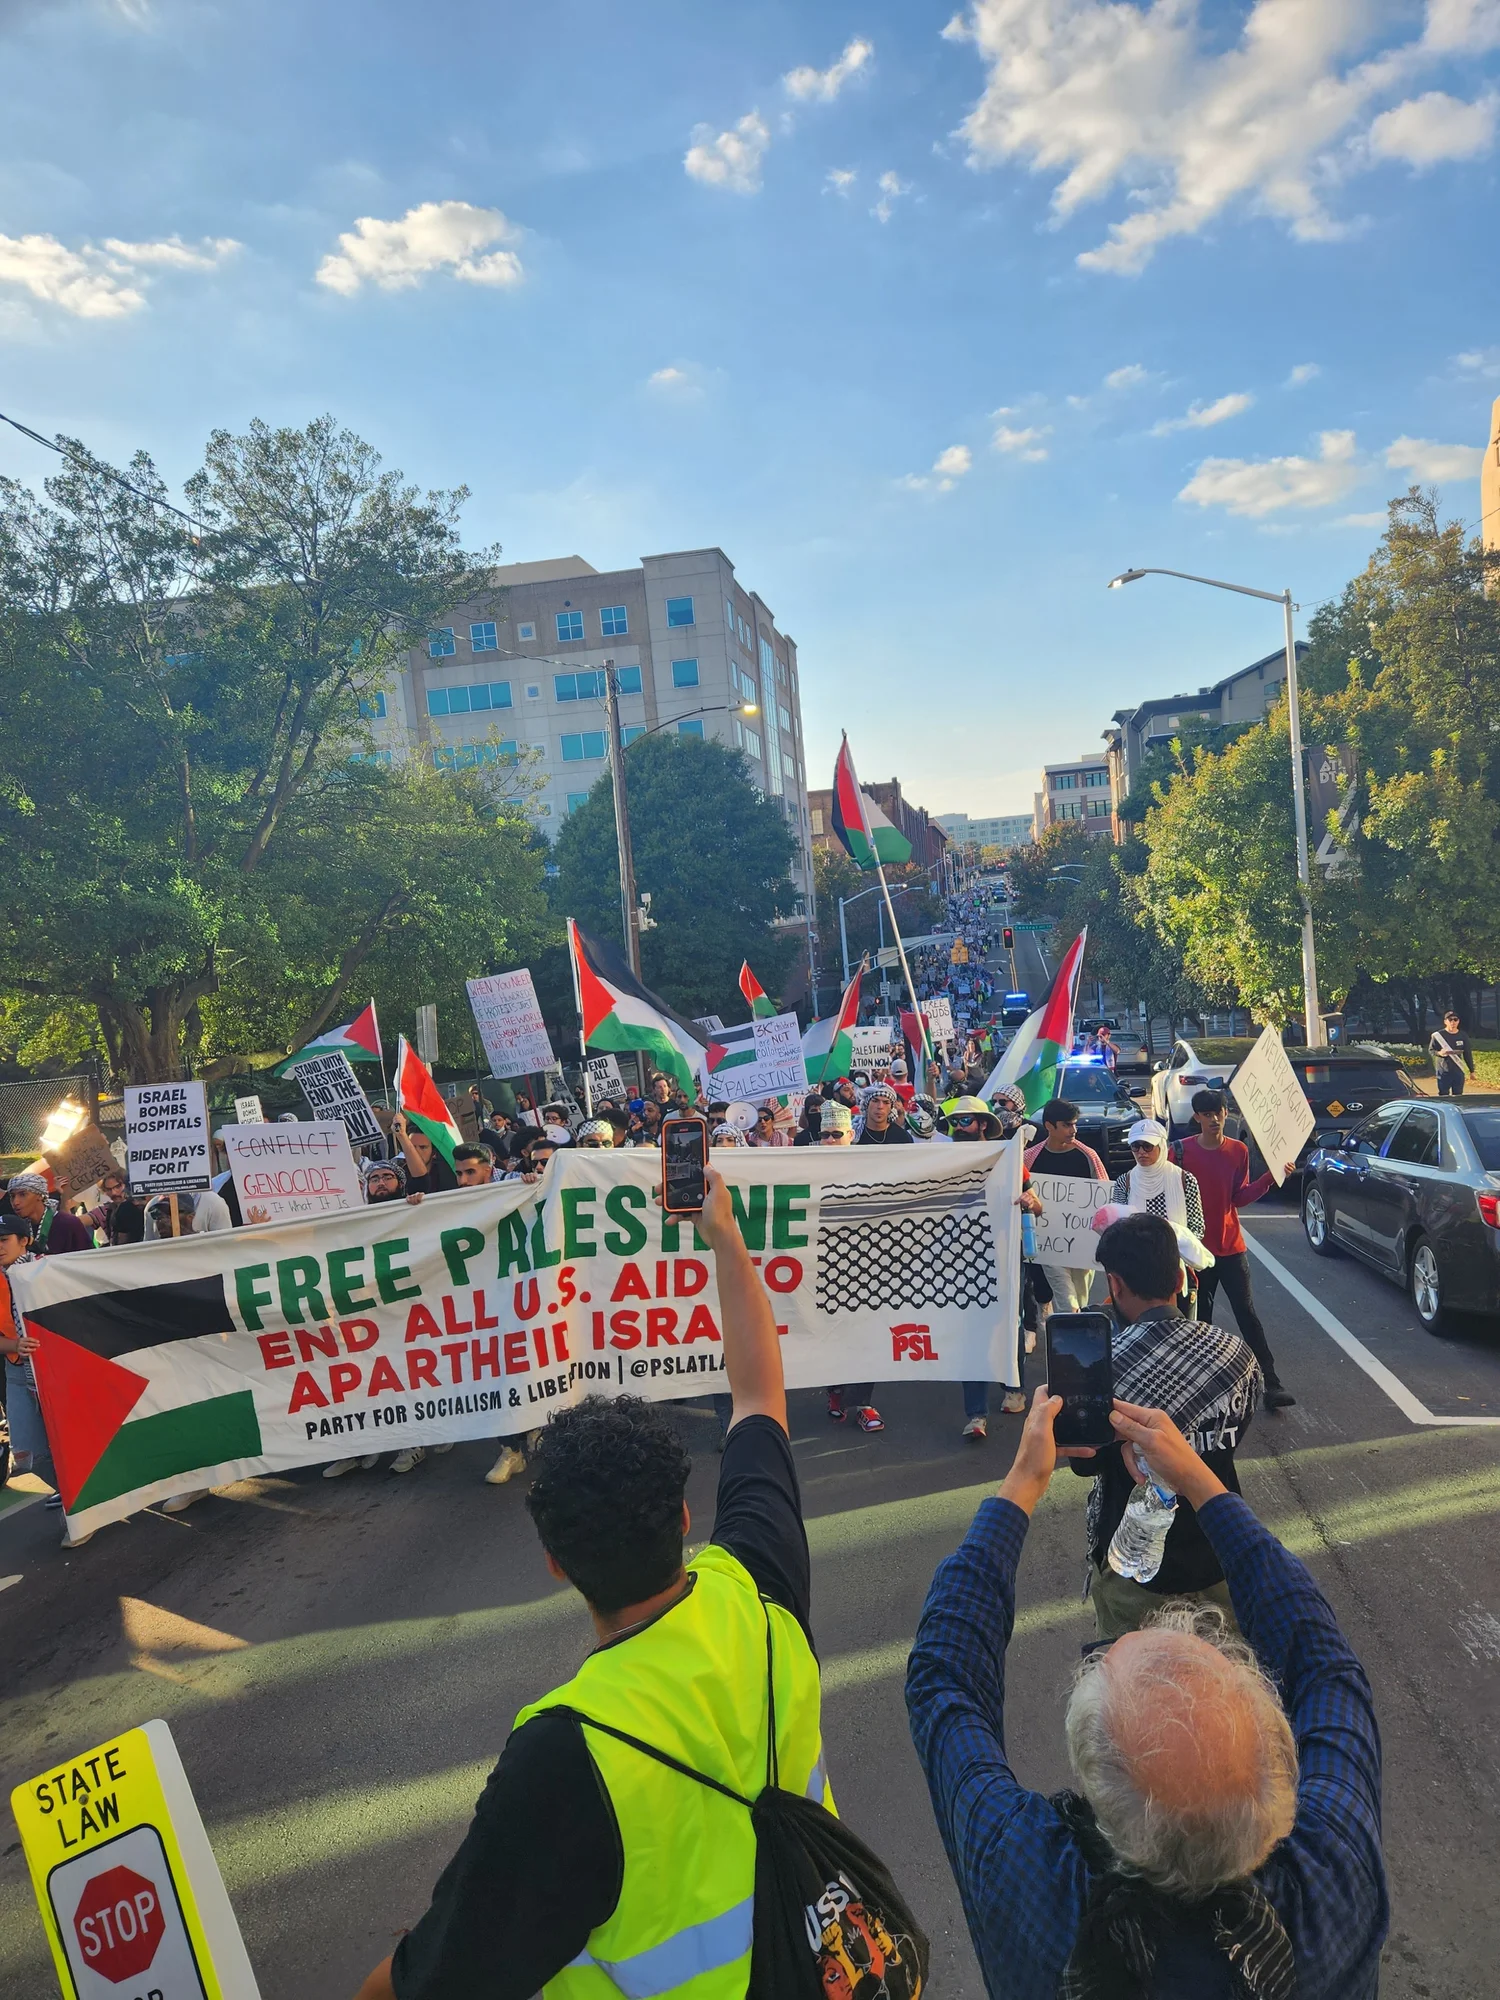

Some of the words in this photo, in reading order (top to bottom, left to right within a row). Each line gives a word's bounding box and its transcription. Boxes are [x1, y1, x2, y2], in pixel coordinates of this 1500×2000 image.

[467, 979, 493, 997] WHEN
[511, 974, 532, 987] NEED
[924, 1000, 945, 1009] FREE
[485, 1019, 502, 1030] TELL
[500, 1016, 516, 1026] THE
[771, 1031, 790, 1046] NOT
[851, 1044, 889, 1055] PALESTINE
[294, 1060, 322, 1078] STAND
[320, 1053, 345, 1071] WITH
[588, 1058, 608, 1072] END
[593, 1069, 610, 1081] ALL
[299, 1066, 351, 1090] PALESTINE!
[589, 1083, 605, 1093] U.S.
[607, 1079, 620, 1089] AID
[725, 1065, 803, 1098] PALESTINE
[1261, 1033, 1288, 1087] NEVER
[1282, 1081, 1314, 1133] AGAIN
[138, 1088, 187, 1104] ISRAEL
[241, 1099, 255, 1108] ISRAEL
[306, 1086, 334, 1107] END
[331, 1079, 360, 1100] THE
[592, 1093, 599, 1102] TO
[1267, 1084, 1282, 1115] FOR
[139, 1103, 187, 1118] BOMBS
[316, 1098, 367, 1120] OCCUPATION
[1242, 1072, 1287, 1160] EVERYONE
[128, 1116, 202, 1134] HOSPITALS
[332, 1109, 377, 1139] OW!
[130, 1147, 169, 1162] BIDEN
[171, 1144, 206, 1158] PAYS
[70, 1160, 110, 1191] CRIMES
[148, 1162, 175, 1176] FOR
[177, 1161, 190, 1173] IT
[243, 1167, 341, 1196] GENOCIDE
[1032, 1180, 1075, 1202] OCIDE
[271, 1202, 284, 1213] It
[288, 1200, 312, 1212] What
[316, 1196, 331, 1210] It
[334, 1194, 350, 1209] Is
[1037, 1235, 1075, 1253] ACY
[234, 1238, 422, 1332] FREE
[440, 1184, 810, 1287] PALESNE
[257, 1318, 380, 1371] END
[404, 1289, 498, 1343] ALL
[513, 1266, 591, 1321] U.S.
[610, 1258, 709, 1302] AID
[749, 1256, 803, 1293] O
[592, 1303, 788, 1351] ISRA
[892, 1333, 939, 1361] PSL
[305, 1411, 366, 1440] PARTY
[373, 1404, 407, 1427] FOR
[414, 1389, 502, 1420] SOCIALISM
[508, 1387, 522, 1407] &
[36, 1747, 126, 1814] STATE
[57, 1792, 121, 1849] LAW
[80, 1890, 156, 1958] STOP
